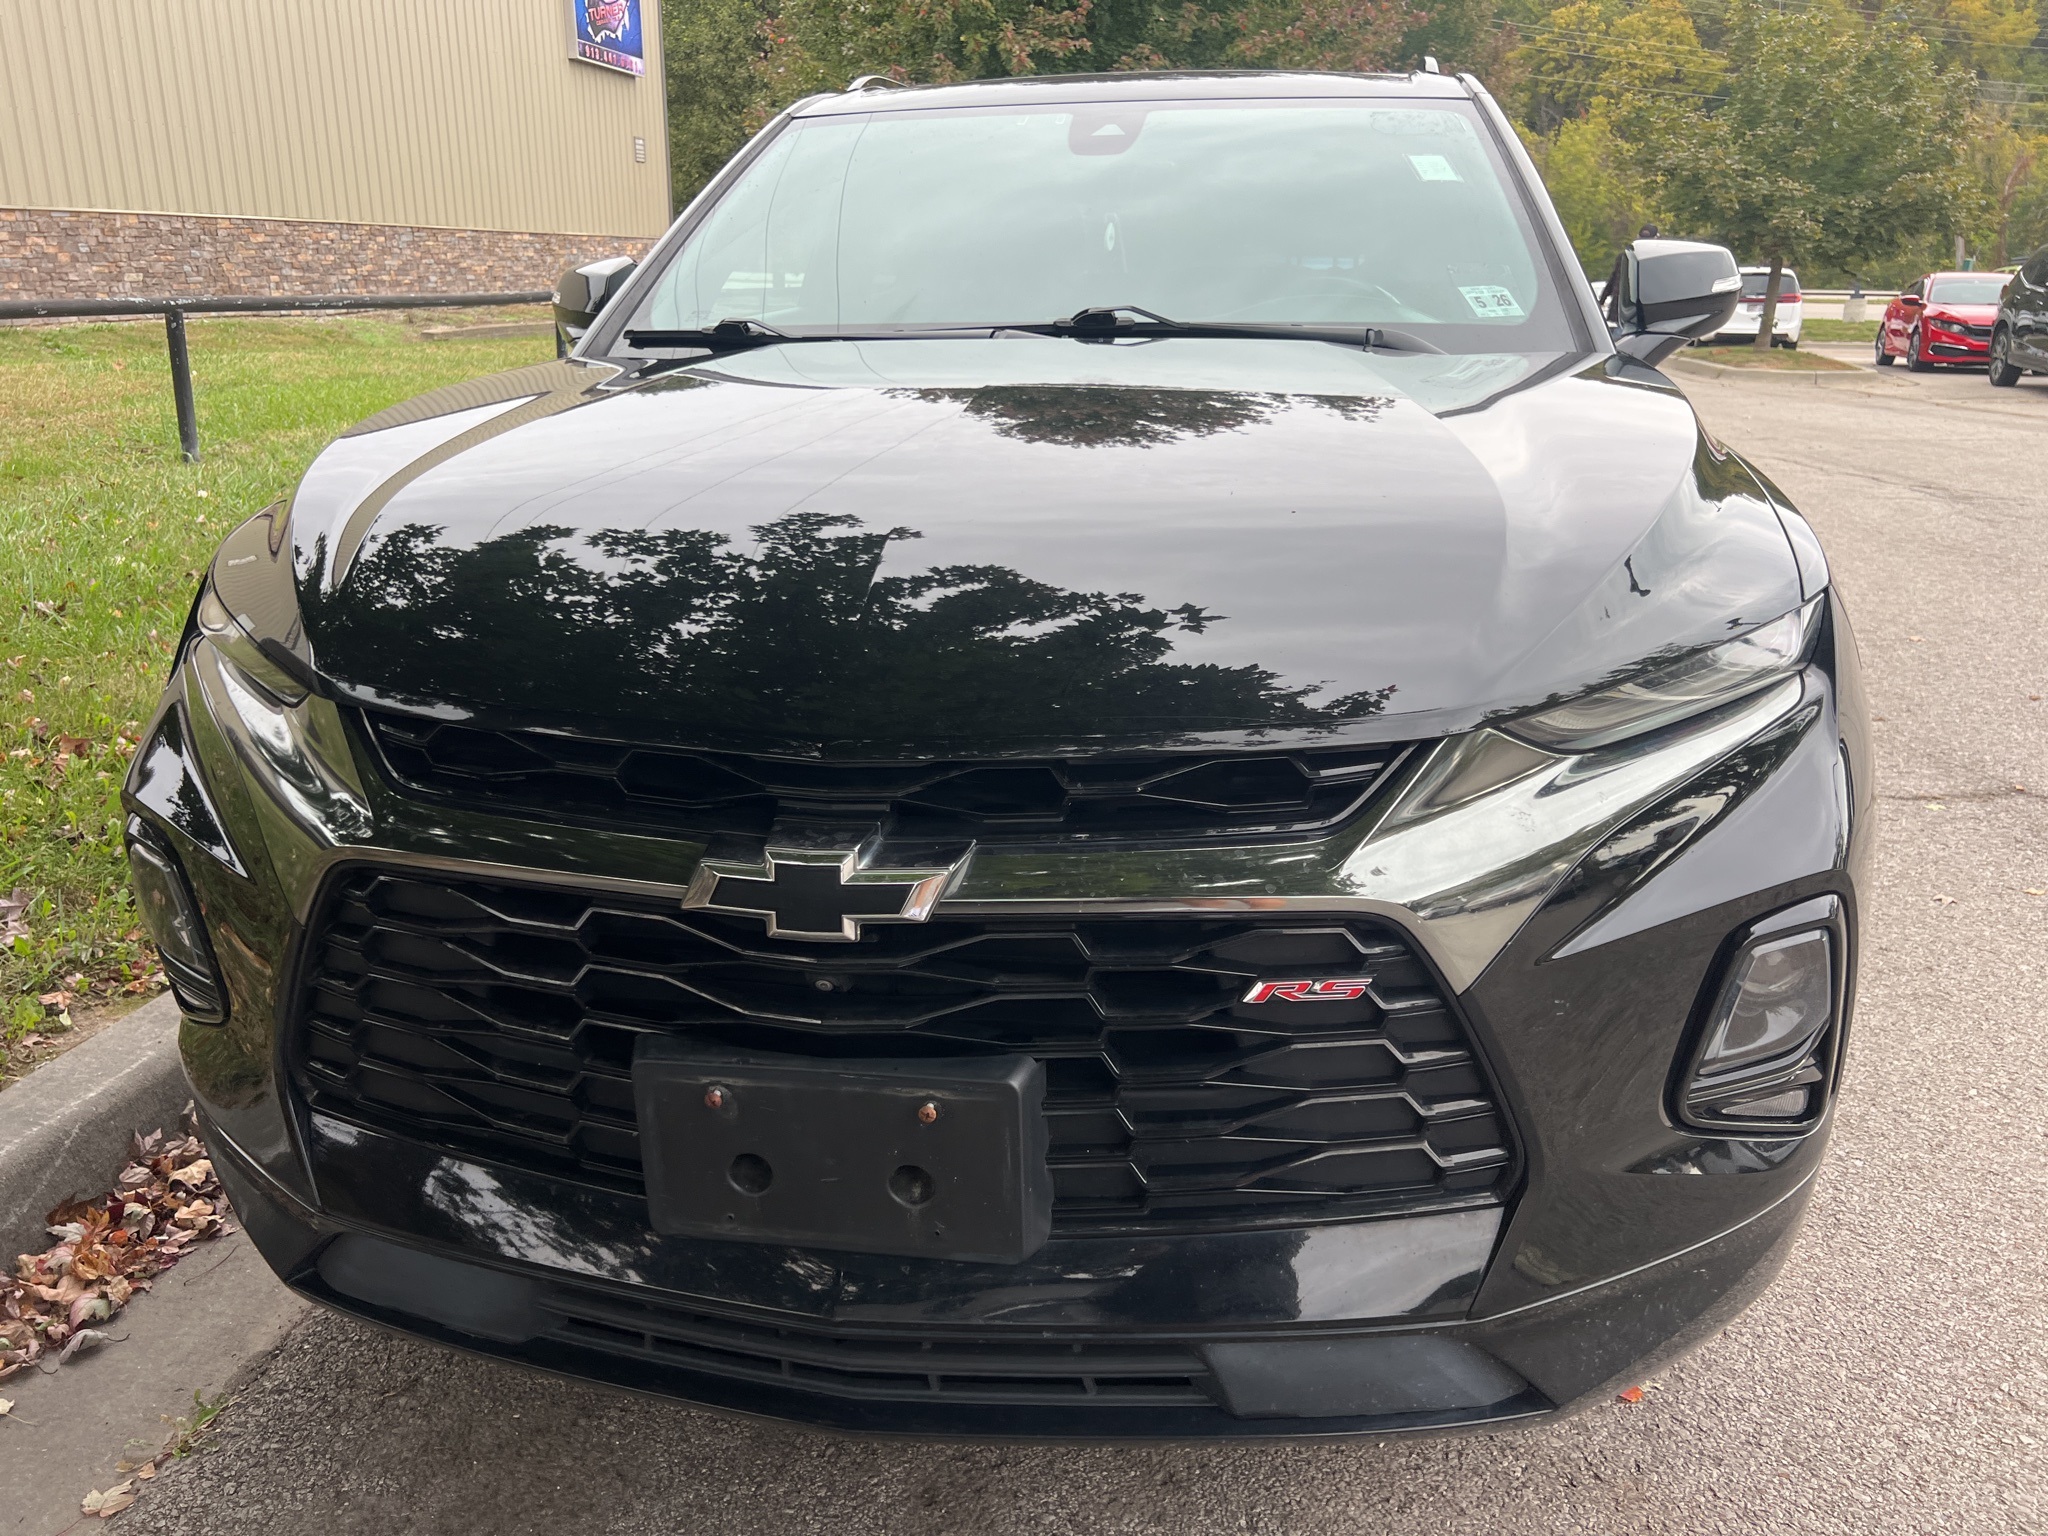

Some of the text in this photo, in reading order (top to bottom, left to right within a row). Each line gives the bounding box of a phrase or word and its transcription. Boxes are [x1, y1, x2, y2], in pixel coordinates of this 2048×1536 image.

[588, 3, 625, 21] TURNER
[1474, 294, 1512, 308] 5 26
[1242, 978, 1373, 1004] RS
